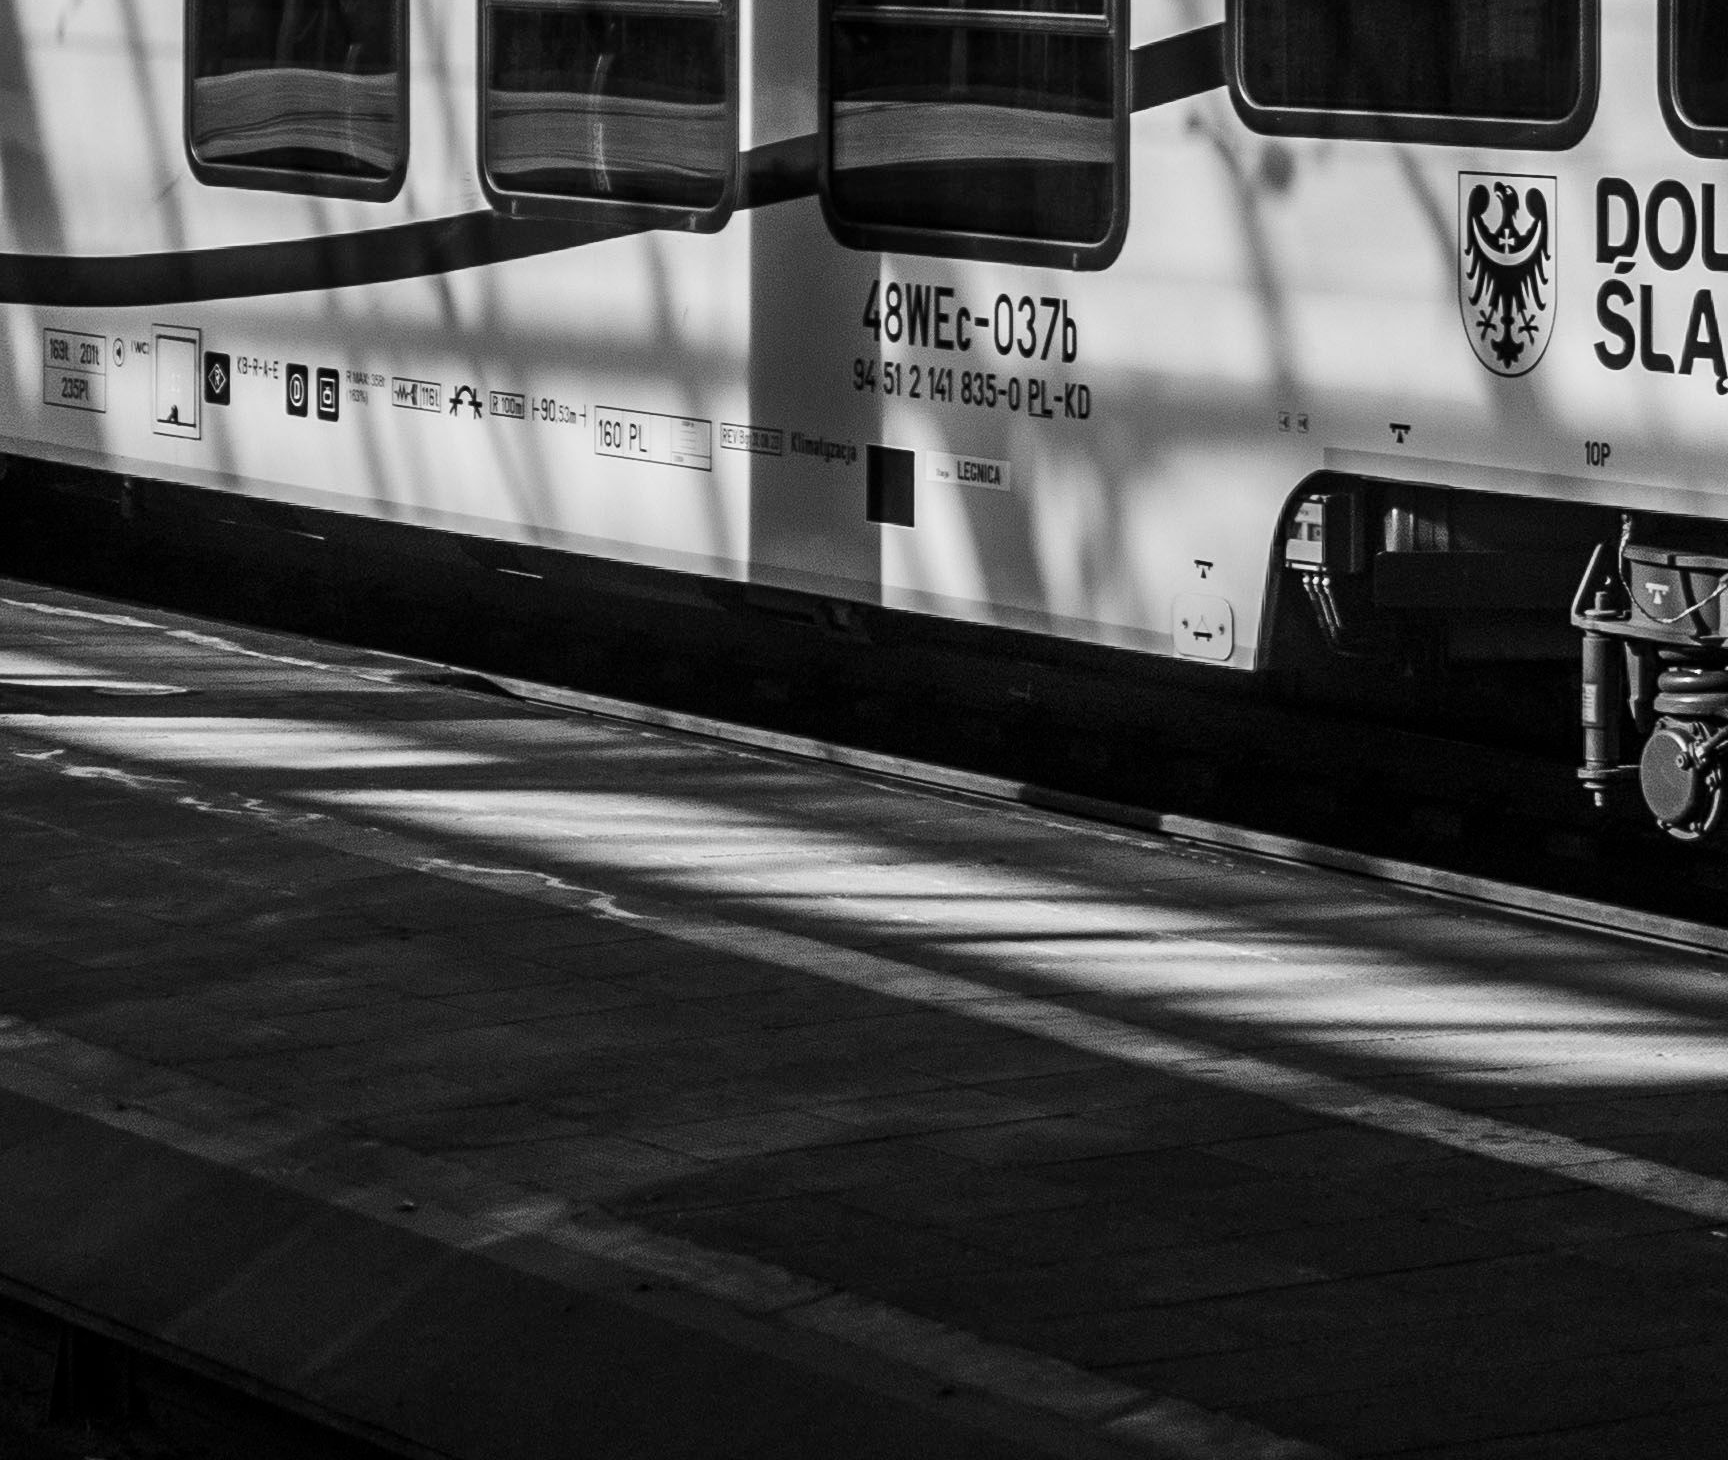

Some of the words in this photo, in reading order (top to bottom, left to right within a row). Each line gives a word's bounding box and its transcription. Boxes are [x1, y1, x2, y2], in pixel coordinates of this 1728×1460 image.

[862, 279, 1078, 364] 48WEc-037b
[492, 395, 499, 412] R
[853, 358, 876, 394] 94
[883, 361, 902, 397] 51
[908, 364, 922, 399] 2
[927, 366, 954, 403] 141
[960, 370, 1021, 412] 835-0
[1028, 378, 1091, 420] PL-KD
[598, 419, 622, 449] 160
[629, 422, 648, 453] PL
[1585, 440, 1611, 466] 10P
[957, 460, 1001, 486] LEGNICA
